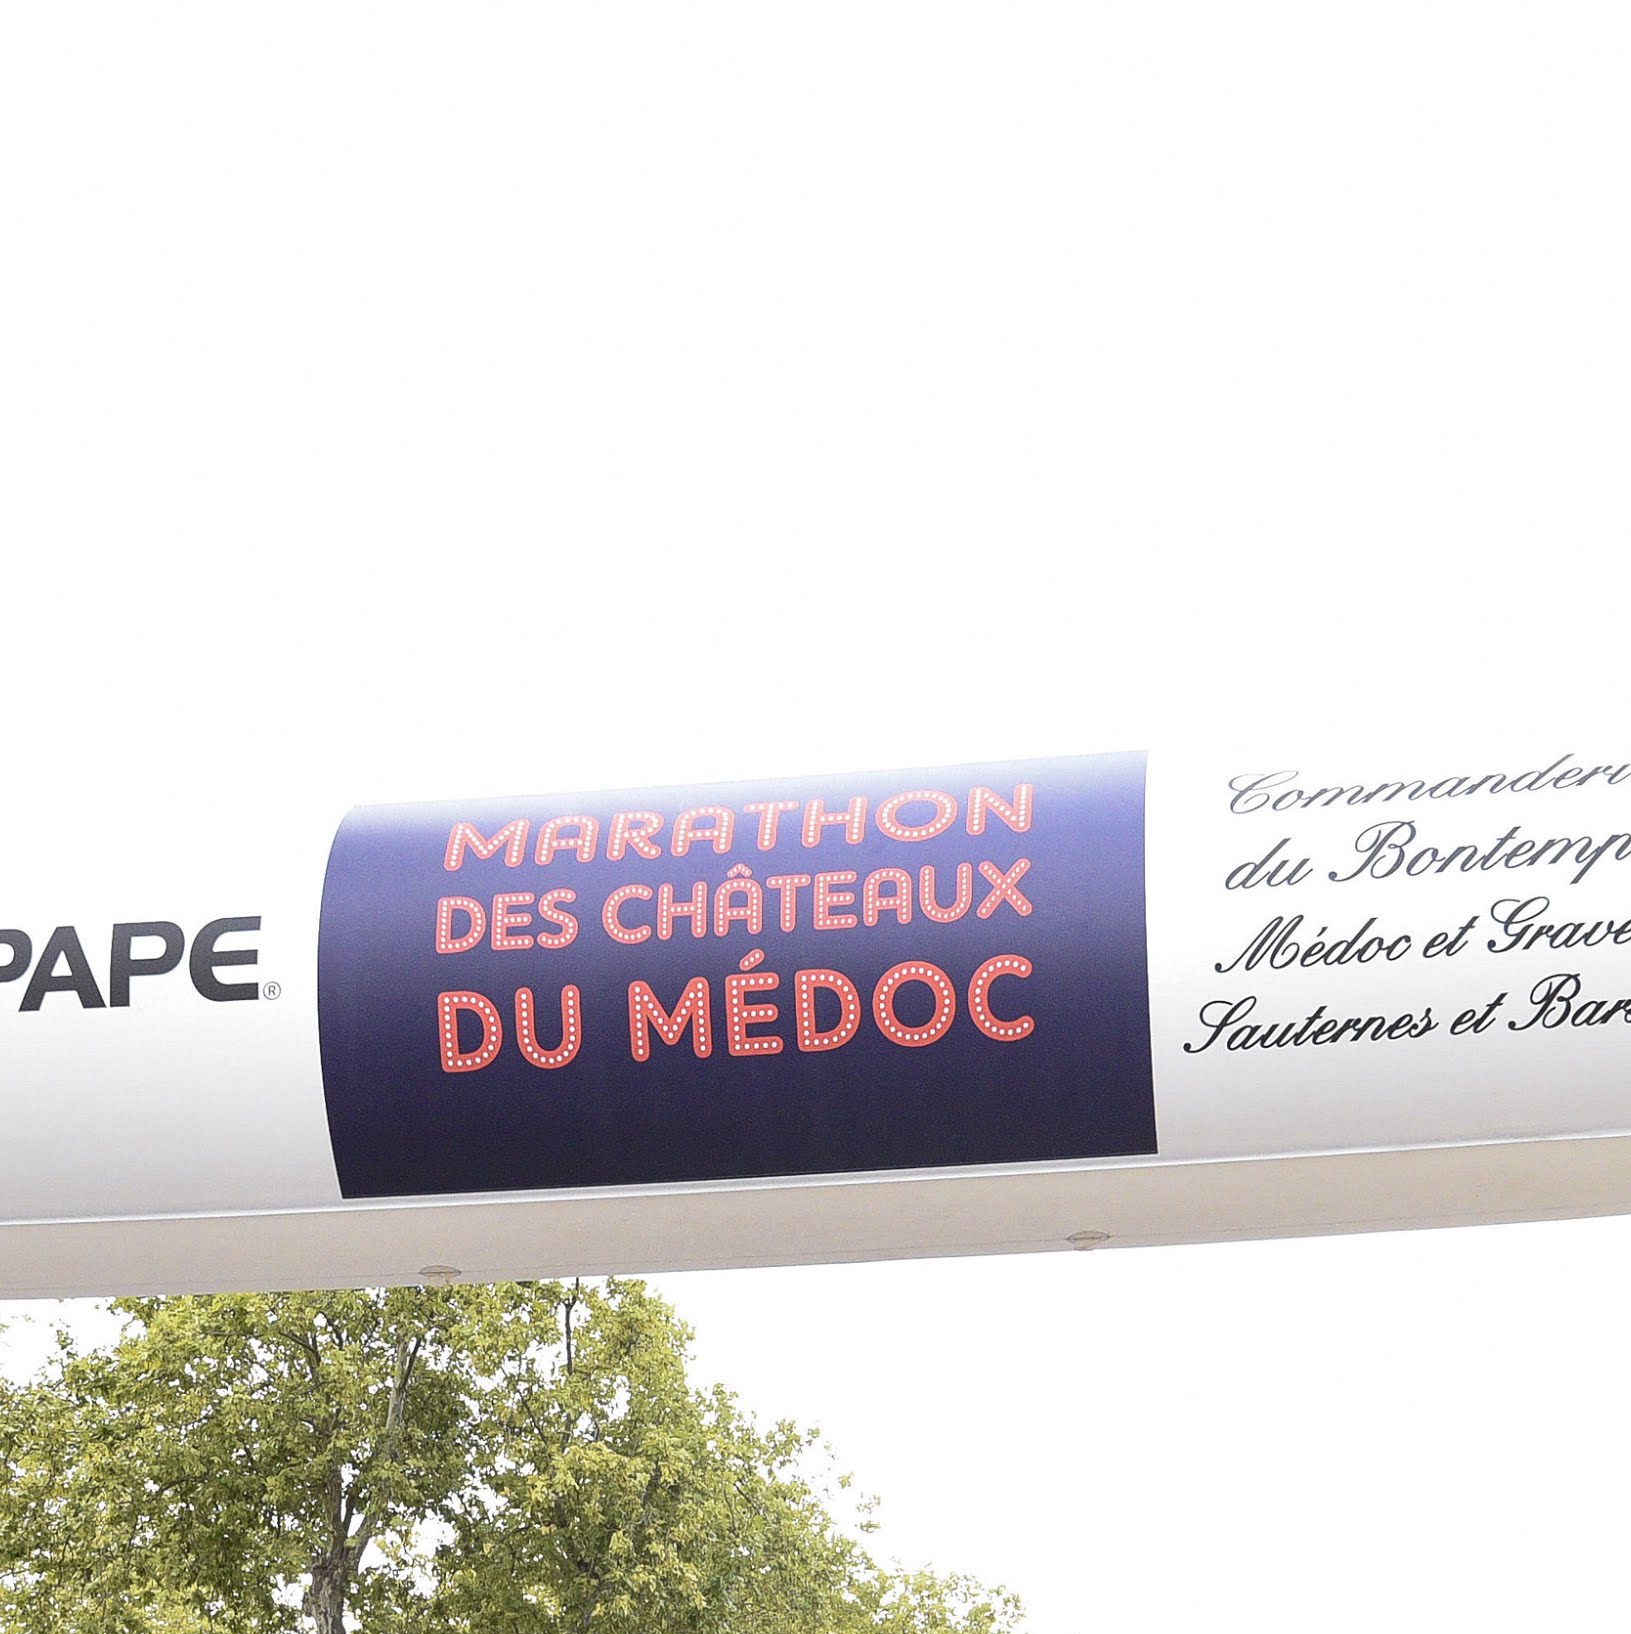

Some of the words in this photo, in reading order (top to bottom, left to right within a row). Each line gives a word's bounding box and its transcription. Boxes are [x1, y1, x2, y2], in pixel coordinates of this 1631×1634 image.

[443, 782, 1035, 872] MARATHON
[1224, 838, 1314, 891] du
[435, 888, 579, 955] DES
[602, 856, 1032, 946] CHÂTEAUX
[1214, 914, 1412, 974] Médoc
[1421, 915, 1481, 959] et
[437, 984, 582, 1073] DU
[627, 948, 1035, 1063] MÉDOC
[1182, 995, 1440, 1055] Sauternes
[1448, 991, 1503, 1036] et
